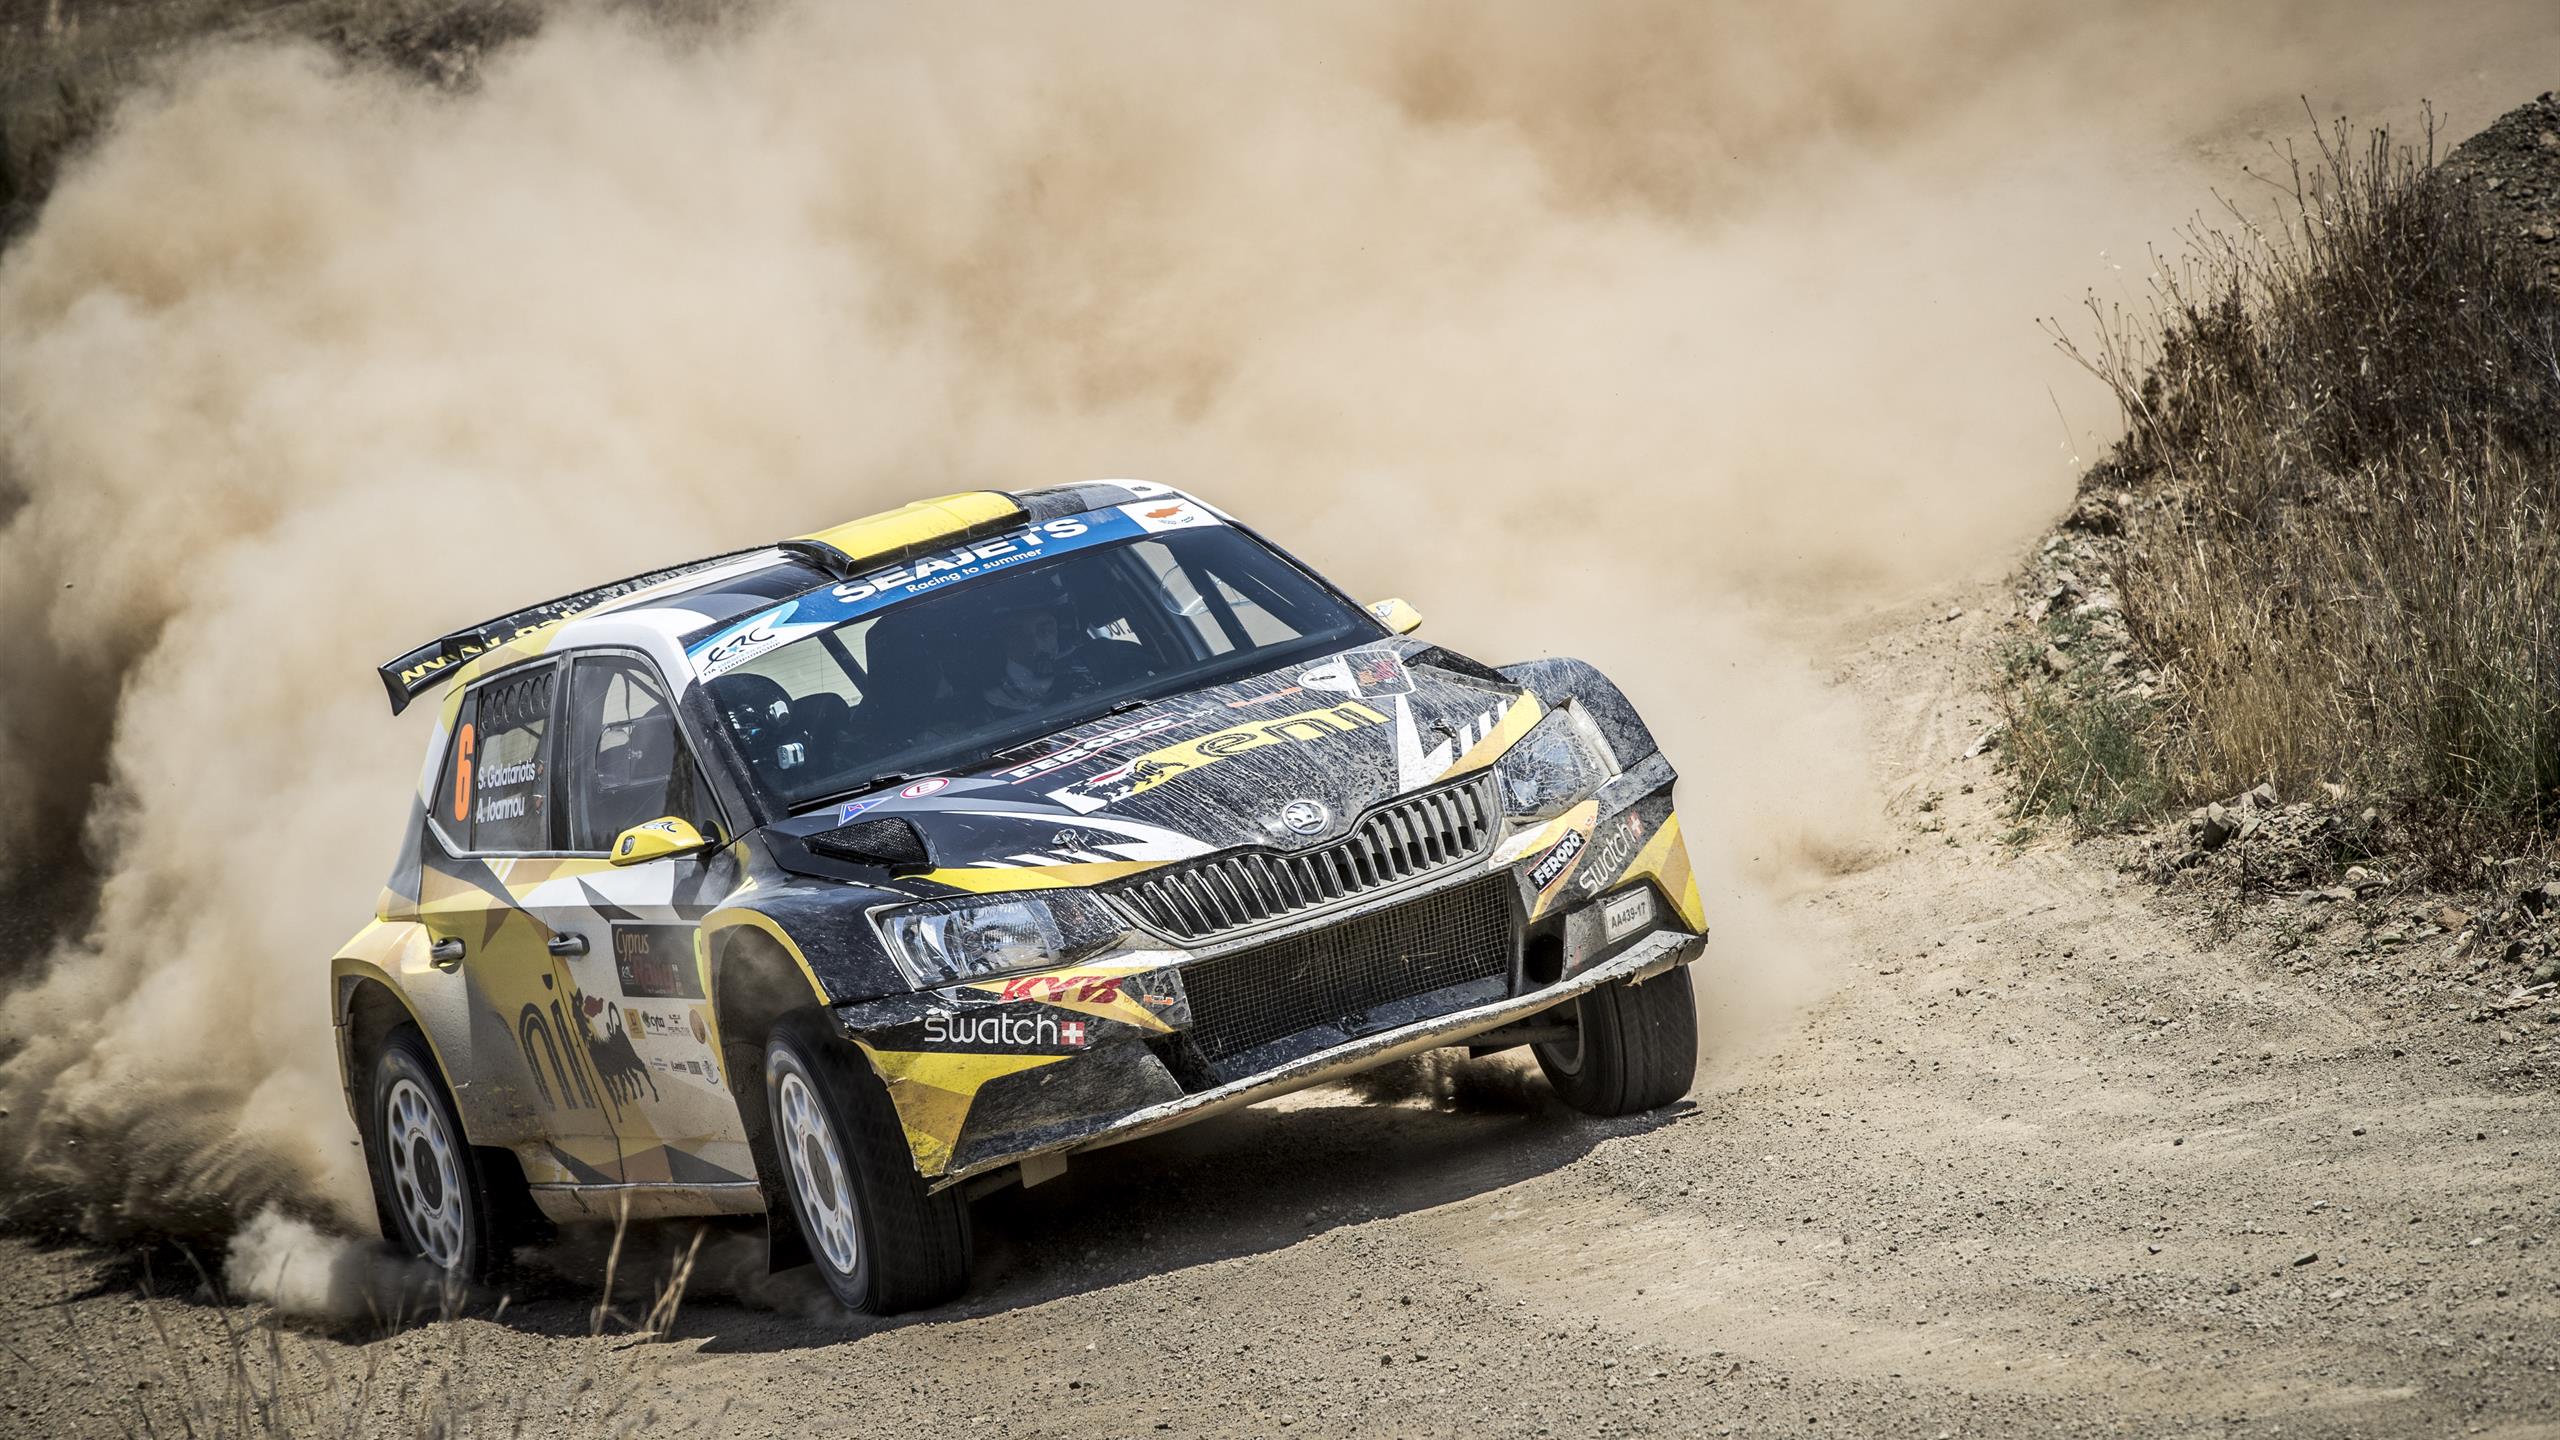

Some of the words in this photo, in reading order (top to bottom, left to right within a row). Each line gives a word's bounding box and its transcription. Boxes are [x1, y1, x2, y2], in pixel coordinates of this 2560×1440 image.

[832, 518, 1088, 603] SEAJETS
[906, 569, 961, 593] Racing
[962, 564, 980, 576] to
[984, 548, 1043, 570] summer
[455, 723, 474, 821] 6
[1011, 718, 1174, 779] FERODO
[478, 766, 486, 790] S.
[476, 798, 485, 823] A.
[1533, 832, 1581, 886] FERODO
[1579, 823, 1636, 900] swatch
[1611, 901, 1647, 929] AA439-17
[616, 928, 650, 962] Cyprus
[924, 1013, 1058, 1046] swatch
[498, 1000, 598, 1113] ni
